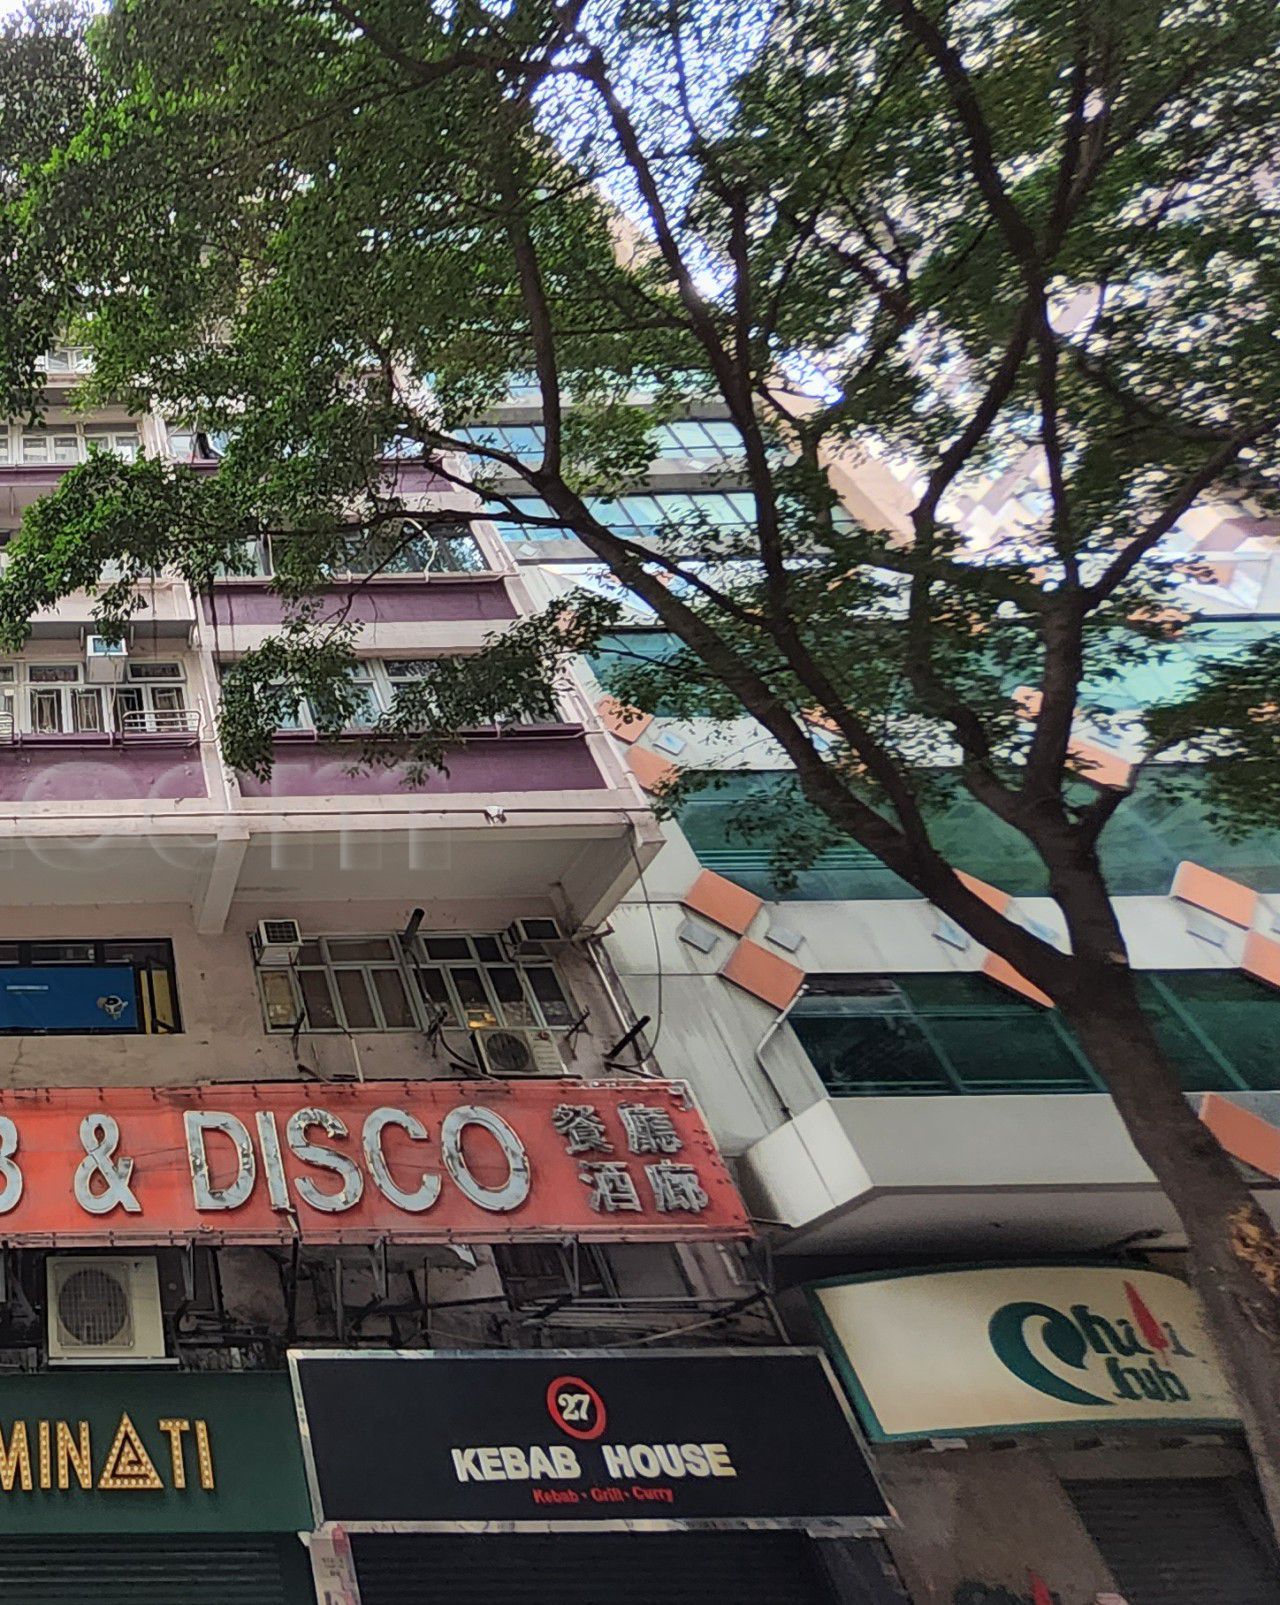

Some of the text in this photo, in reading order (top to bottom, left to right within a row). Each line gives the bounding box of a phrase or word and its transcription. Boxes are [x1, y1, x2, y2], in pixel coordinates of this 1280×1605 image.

[551, 1103, 684, 1156] 餐廳
[74, 1113, 142, 1214] &
[183, 1105, 532, 1213] DISCO
[578, 1159, 709, 1214] 酒廊
[558, 1393, 591, 1421] 27
[451, 1443, 737, 1482] KEBAB HOUSE
[532, 1486, 674, 1504] Kebab Grill Curry
